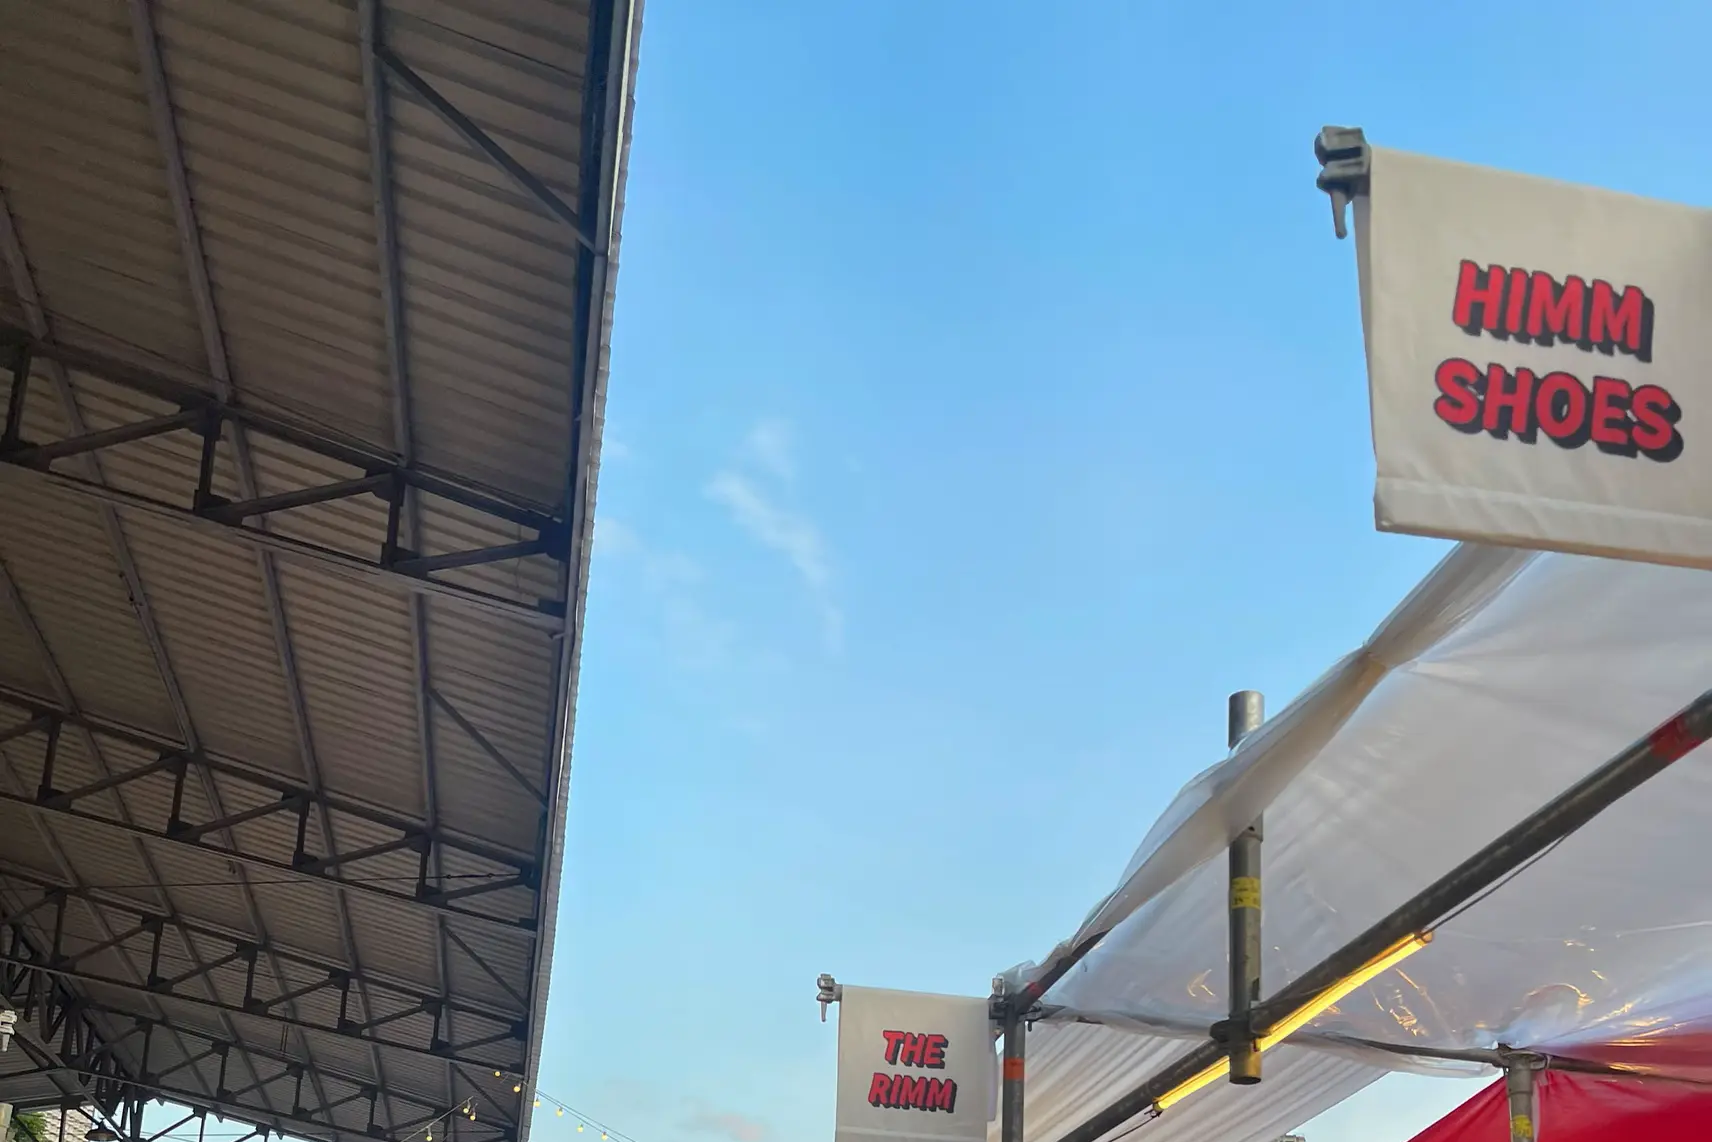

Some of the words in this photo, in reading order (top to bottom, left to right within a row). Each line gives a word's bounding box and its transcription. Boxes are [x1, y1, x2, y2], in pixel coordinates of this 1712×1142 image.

[1453, 259, 1654, 363] HIMM
[1433, 358, 1684, 463] SHOES
[883, 1030, 949, 1069] THE
[868, 1072, 957, 1114] RIMM
